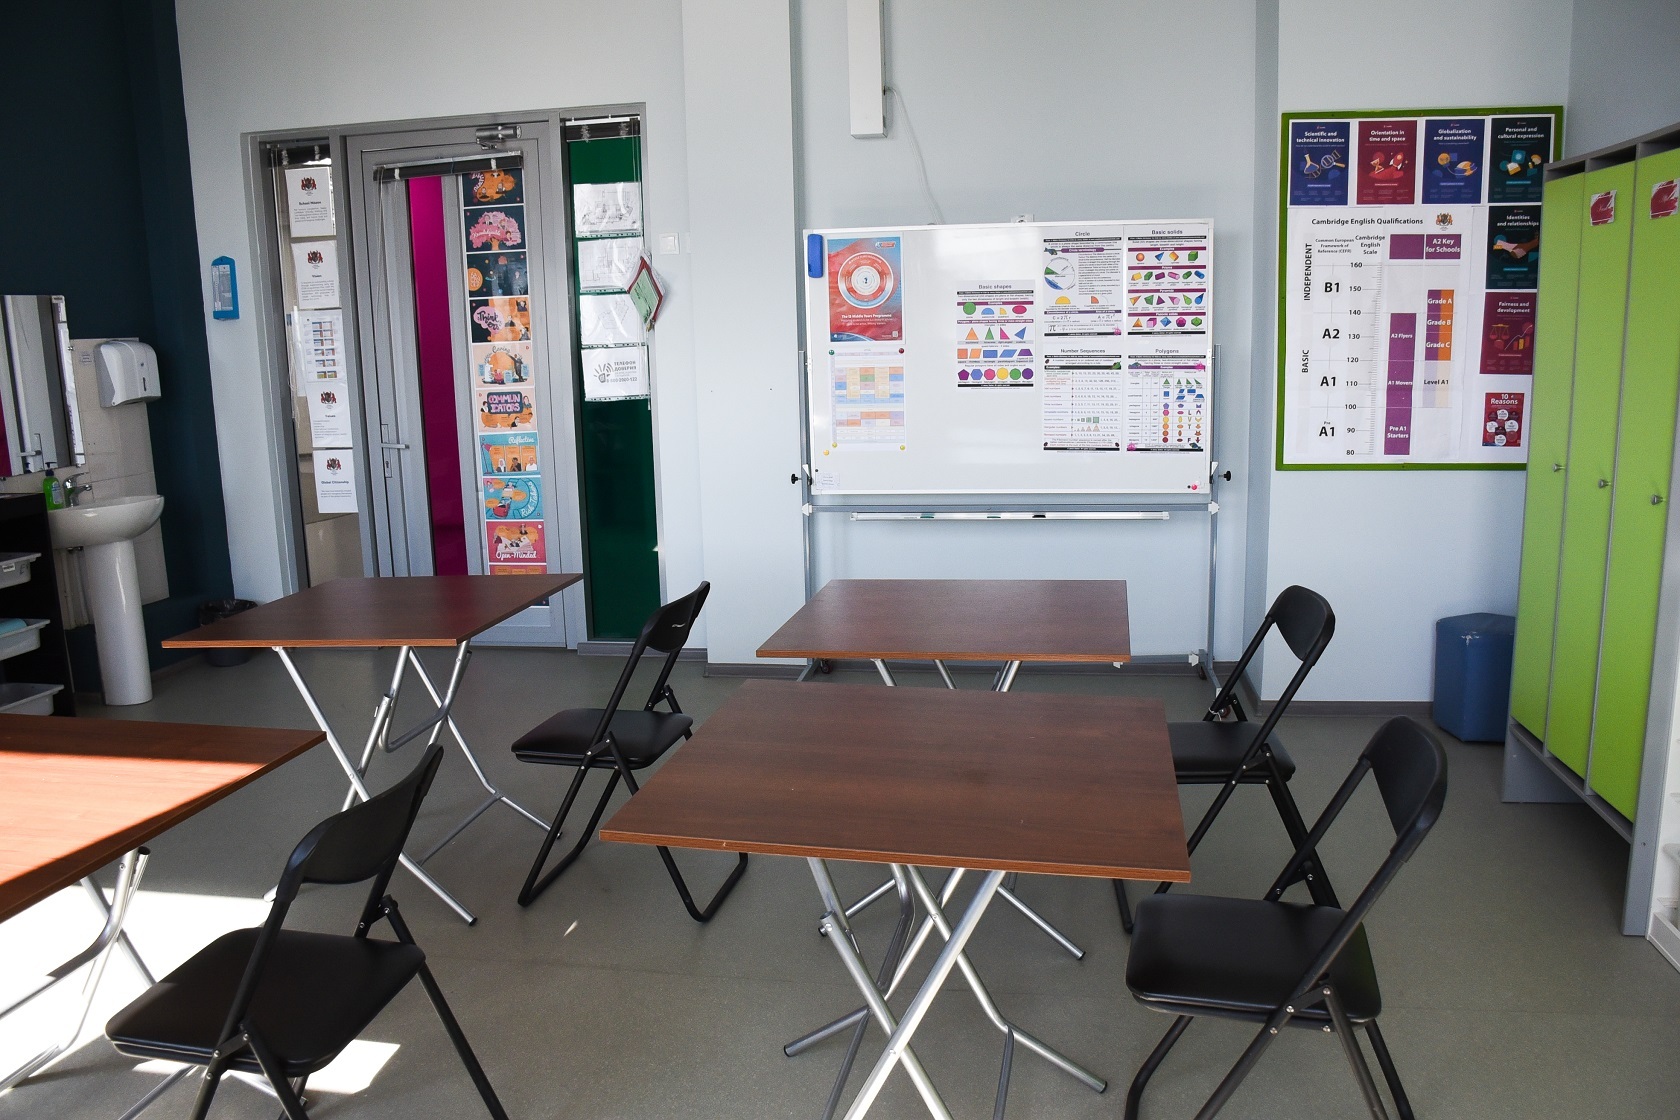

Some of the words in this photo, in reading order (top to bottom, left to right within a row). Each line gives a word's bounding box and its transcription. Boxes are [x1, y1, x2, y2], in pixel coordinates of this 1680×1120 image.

[1311, 218, 1349, 226] Cambridge
[1350, 218, 1375, 226] English
[1376, 217, 1424, 225] Qualifications
[1355, 234, 1386, 242] Cambridge
[1442, 238, 1455, 246] Key
[1304, 243, 1312, 301] INDEPENDENT
[1324, 281, 1340, 293] B1
[1322, 328, 1340, 339] A2
[1320, 375, 1337, 387] A1
[1318, 426, 1335, 437] A1
